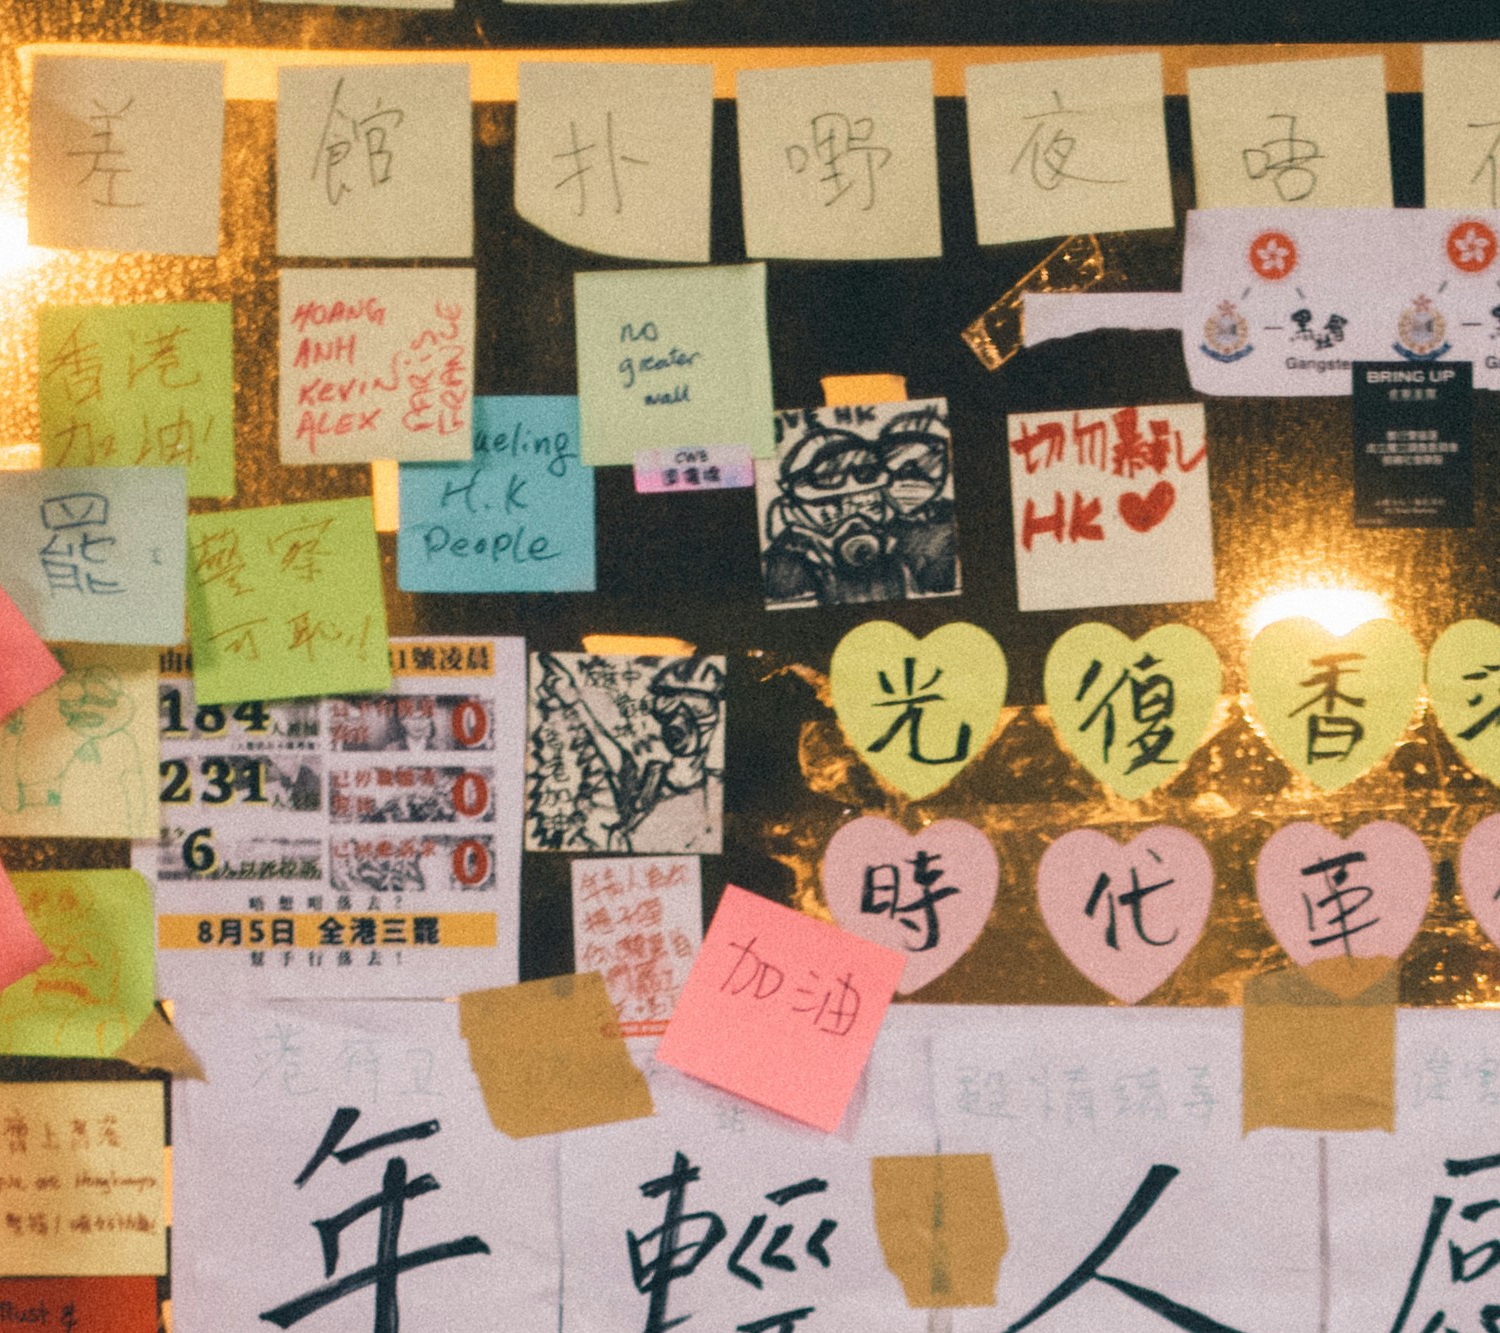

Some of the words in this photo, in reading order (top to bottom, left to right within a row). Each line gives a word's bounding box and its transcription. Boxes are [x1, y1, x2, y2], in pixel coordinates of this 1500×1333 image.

[618, 349, 701, 389] greater
[1428, 369, 1456, 383] UP
[297, 411, 381, 440] ALEX
[1021, 492, 1105, 549] HK
[420, 529, 553, 563] People
[182, 827, 216, 872] 6
[196, 917, 297, 946] 8月5日
[318, 917, 441, 946] 全港三罷
[727, 936, 865, 1038] 加油
